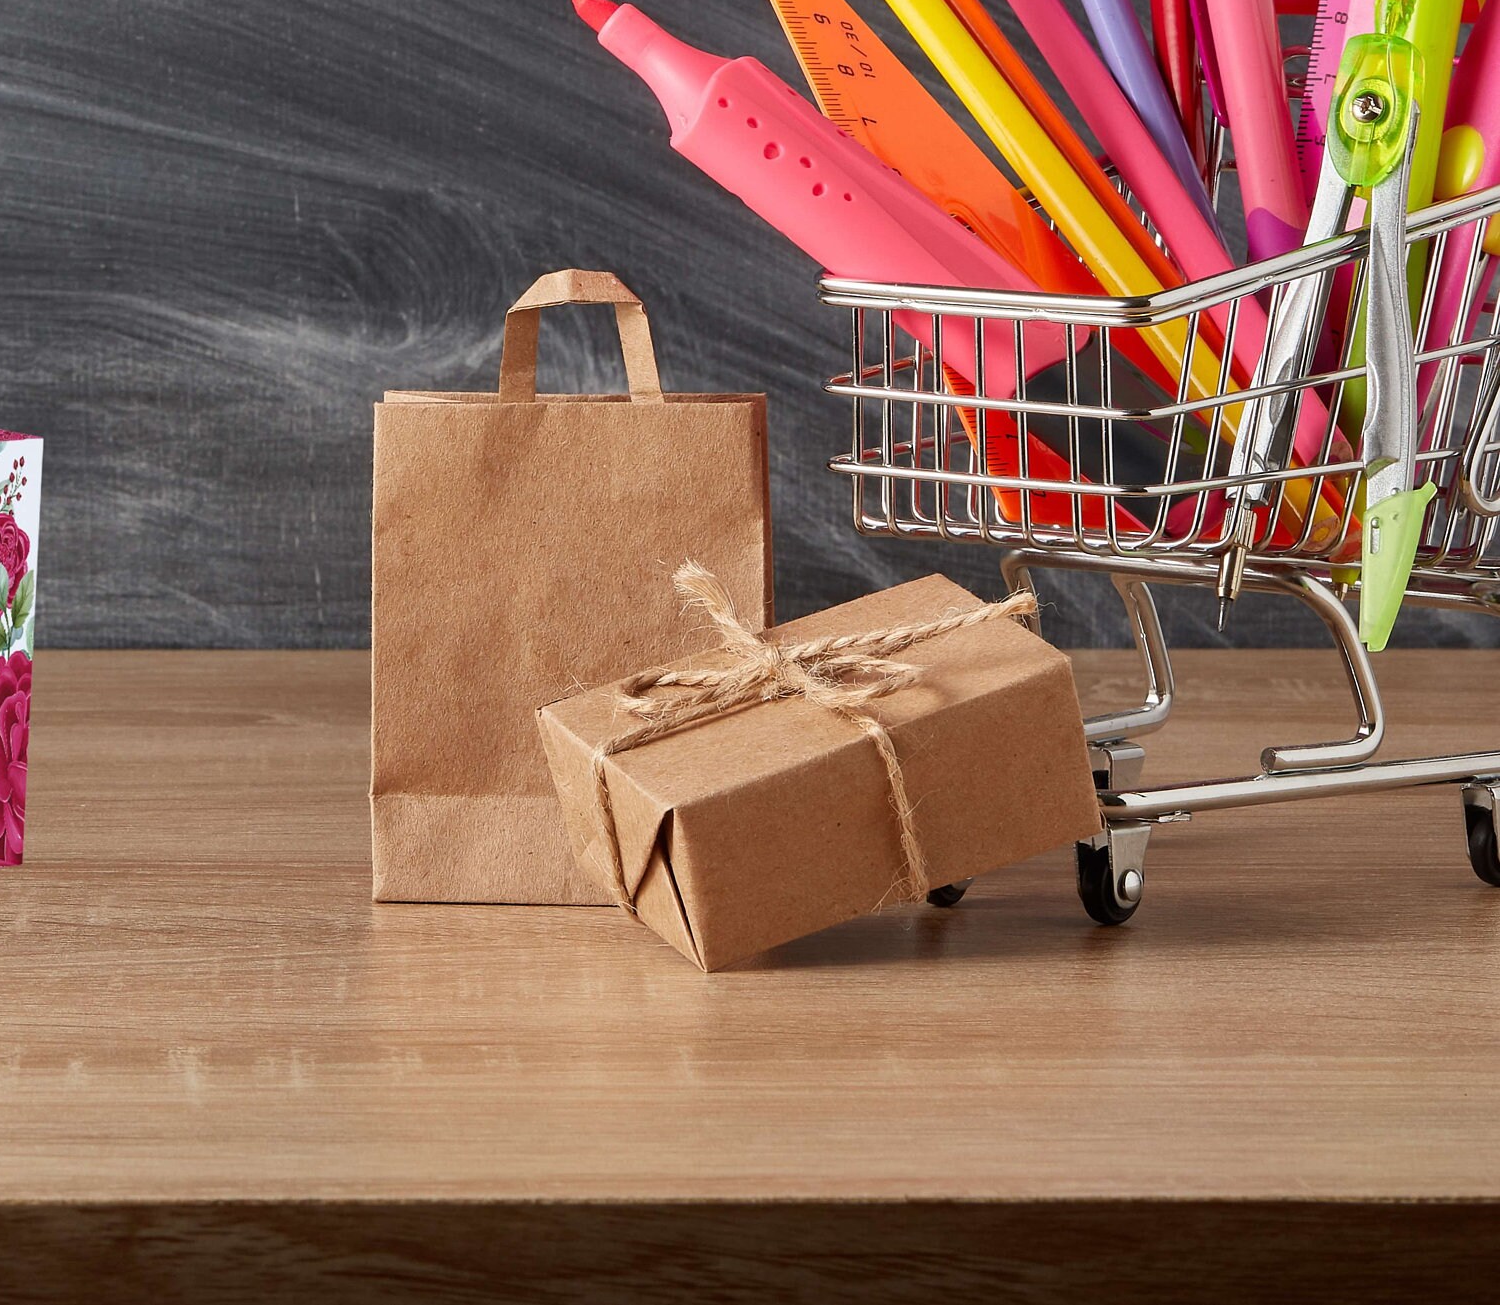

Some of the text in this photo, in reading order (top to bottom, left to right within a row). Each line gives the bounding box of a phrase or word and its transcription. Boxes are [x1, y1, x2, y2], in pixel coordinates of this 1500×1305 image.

[814, 13, 831, 25] 9
[1334, 11, 1349, 25] 8
[837, 63, 855, 76] 8
[861, 116, 877, 127] 7
